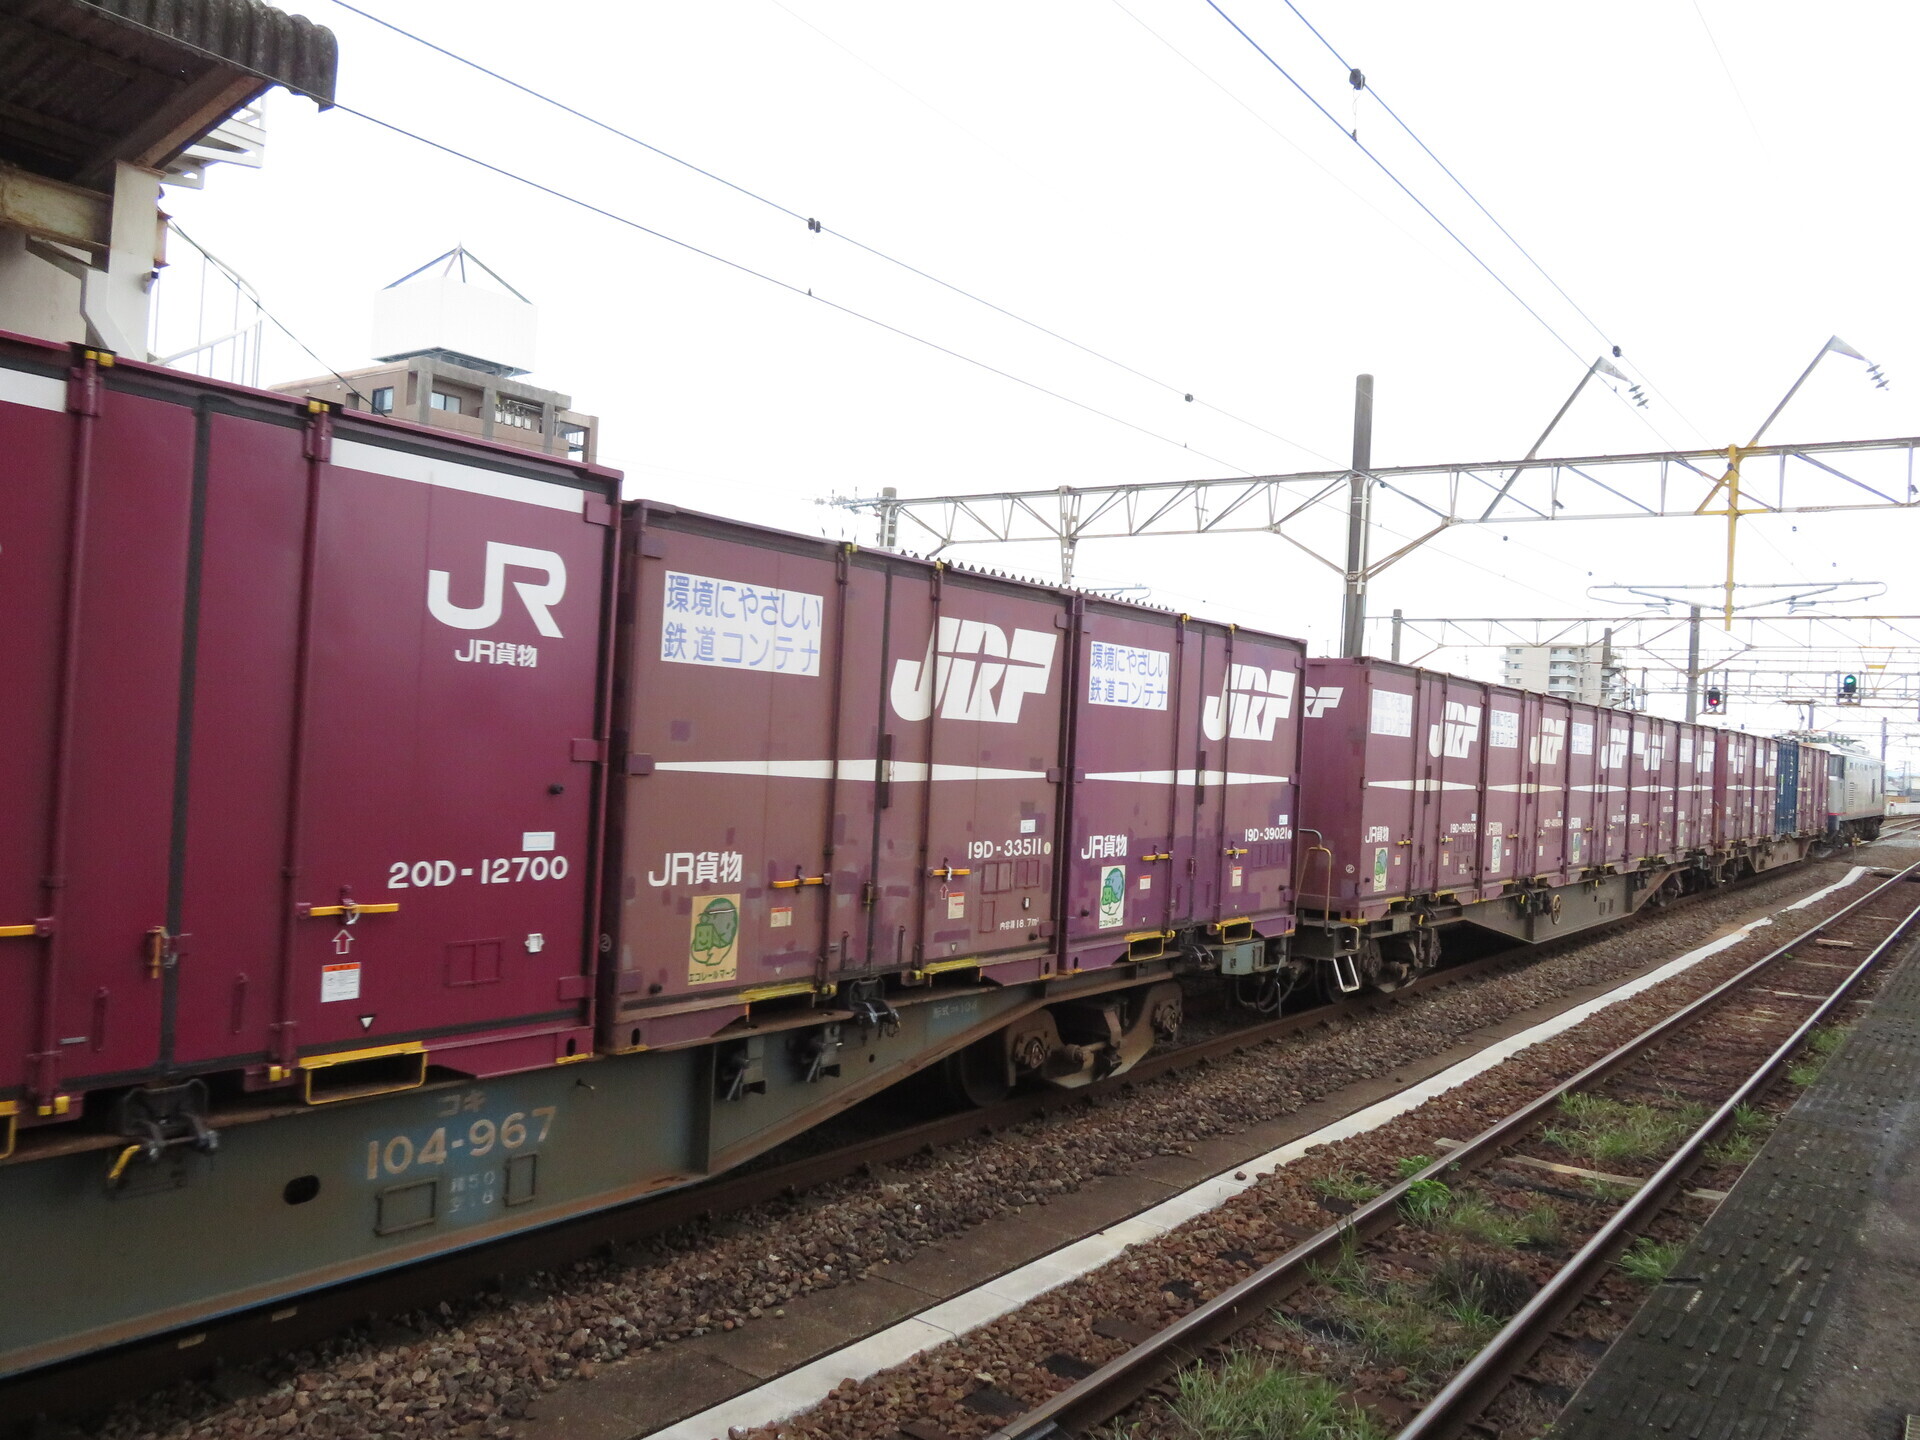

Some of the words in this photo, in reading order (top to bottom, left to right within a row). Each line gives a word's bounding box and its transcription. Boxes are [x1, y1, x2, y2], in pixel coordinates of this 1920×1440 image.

[427, 541, 567, 638] JR
[667, 575, 820, 630] 環境にやさしい
[455, 639, 537, 667] JR貨物
[664, 621, 818, 672] 鉄道コンテナ
[1092, 644, 1168, 677] 環境にやさしい
[890, 616, 1057, 724] JRF
[1090, 676, 1166, 707] 鉄道コンテナ
[1203, 663, 1296, 741] JRF
[968, 838, 1041, 859] 19D-33511
[1081, 834, 1127, 859] JR貨物
[388, 856, 568, 888] 20D-12700
[648, 851, 743, 886] JR貨物
[367, 1106, 556, 1180] 104-967
